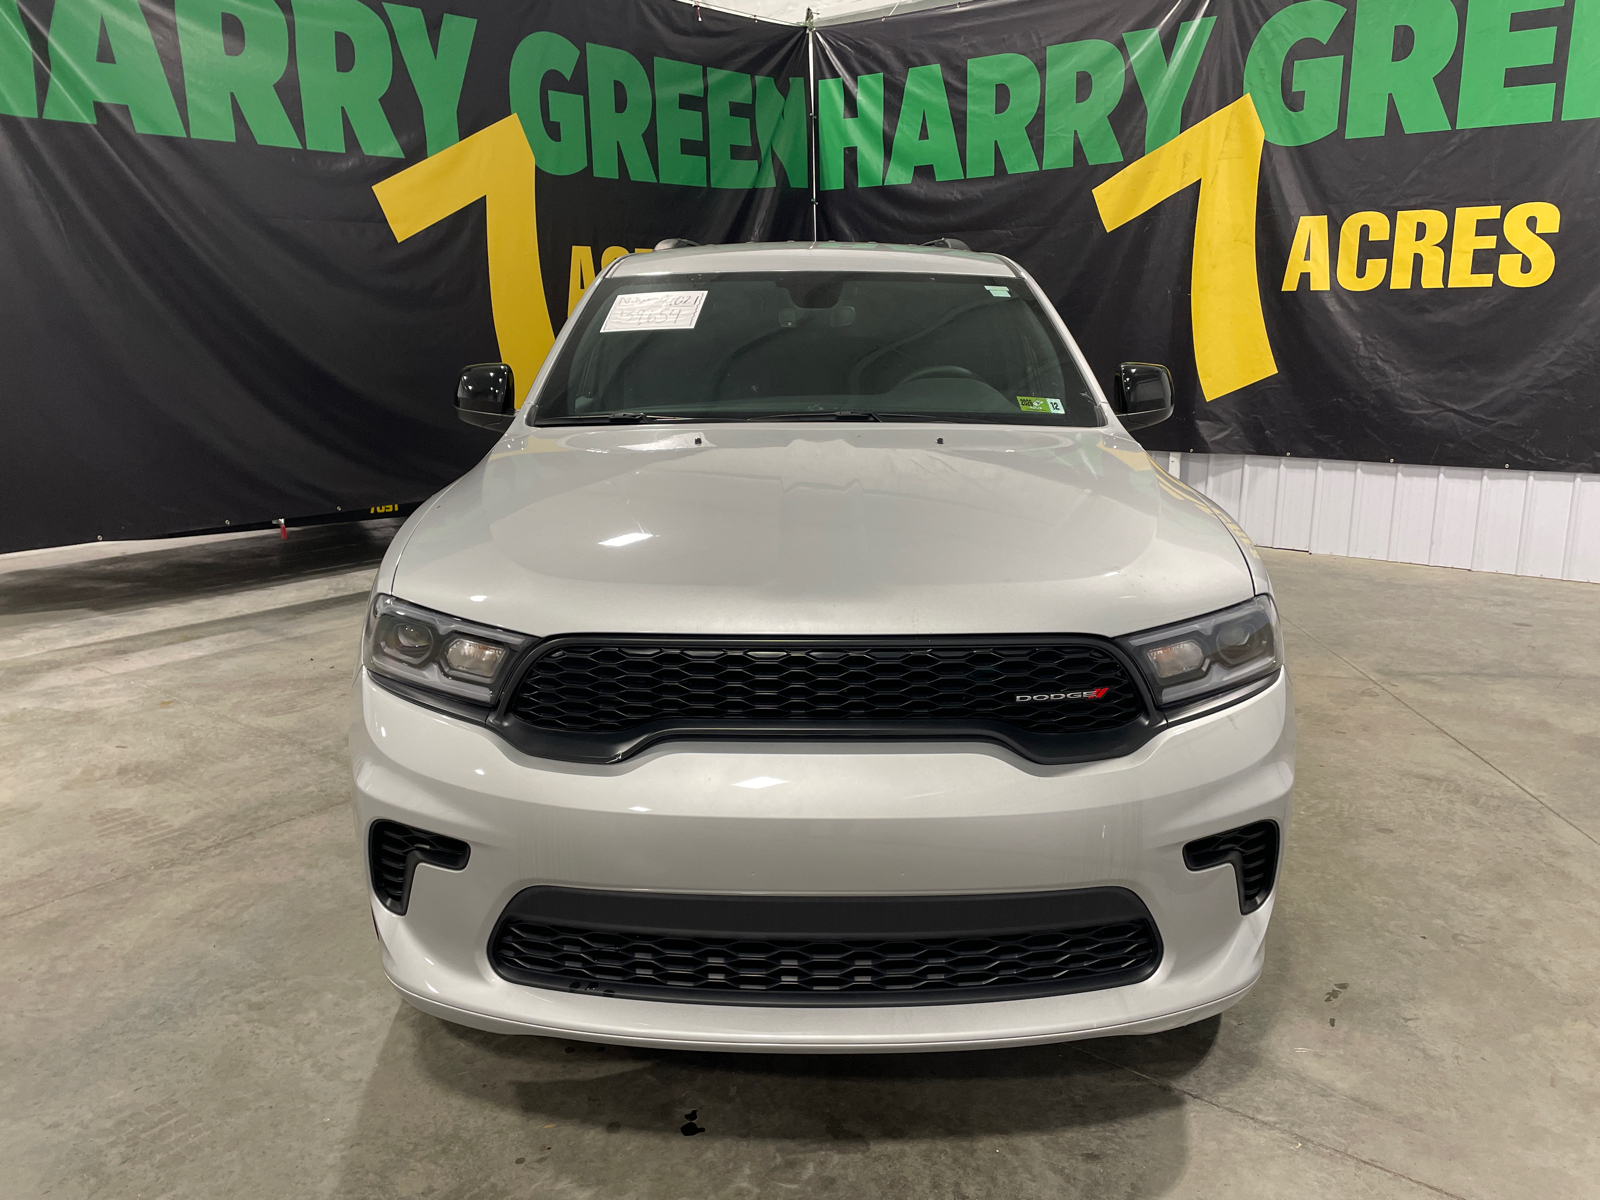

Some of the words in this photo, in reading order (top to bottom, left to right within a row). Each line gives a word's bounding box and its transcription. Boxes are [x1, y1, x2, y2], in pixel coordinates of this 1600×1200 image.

[0, 0, 477, 159] ARRY
[508, 31, 808, 189] GREEN
[818, 15, 1218, 191] HARRY
[372, 113, 556, 410] 7
[1092, 93, 1278, 402] 7
[1281, 202, 1560, 291] ACRES
[1050, 401, 1061, 411] 12
[1015, 690, 1098, 702] DODGE
